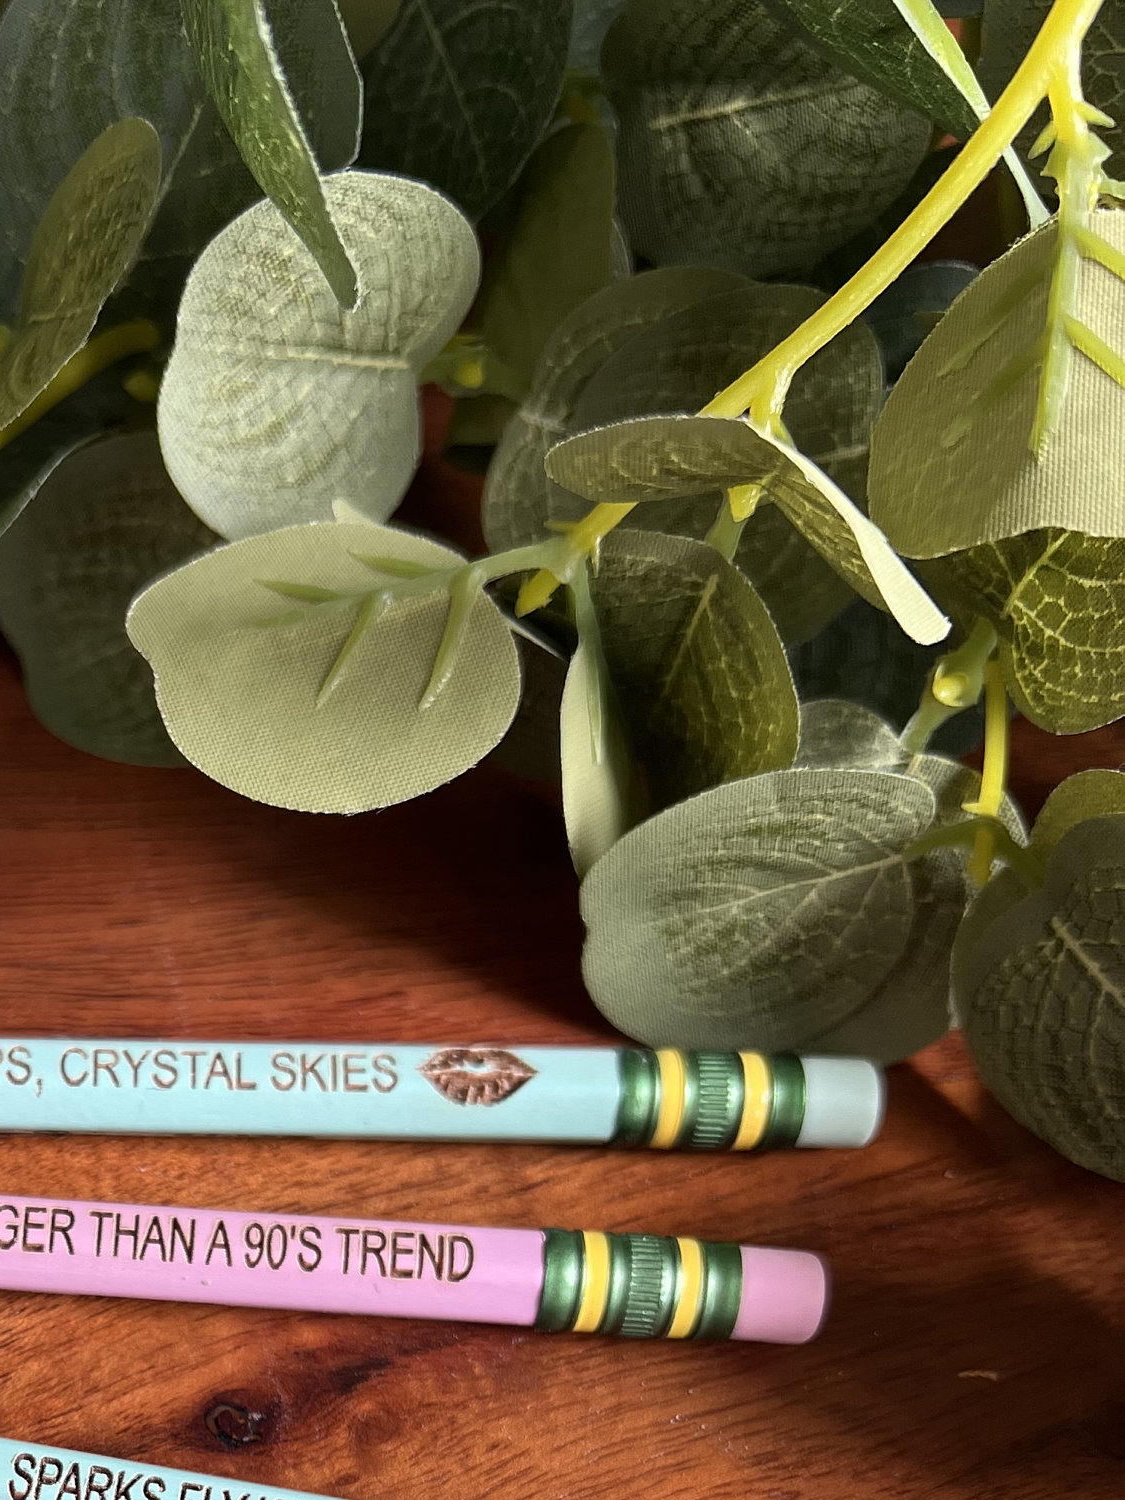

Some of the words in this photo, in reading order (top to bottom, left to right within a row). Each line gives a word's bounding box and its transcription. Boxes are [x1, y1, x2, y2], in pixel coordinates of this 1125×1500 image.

[60, 1047, 257, 1092] CRYSTAL
[270, 1052, 398, 1093] SKIES
[89, 1210, 196, 1265] THAN
[205, 1219, 232, 1267] A
[243, 1221, 322, 1272] 90'S
[336, 1227, 475, 1283] TREND
